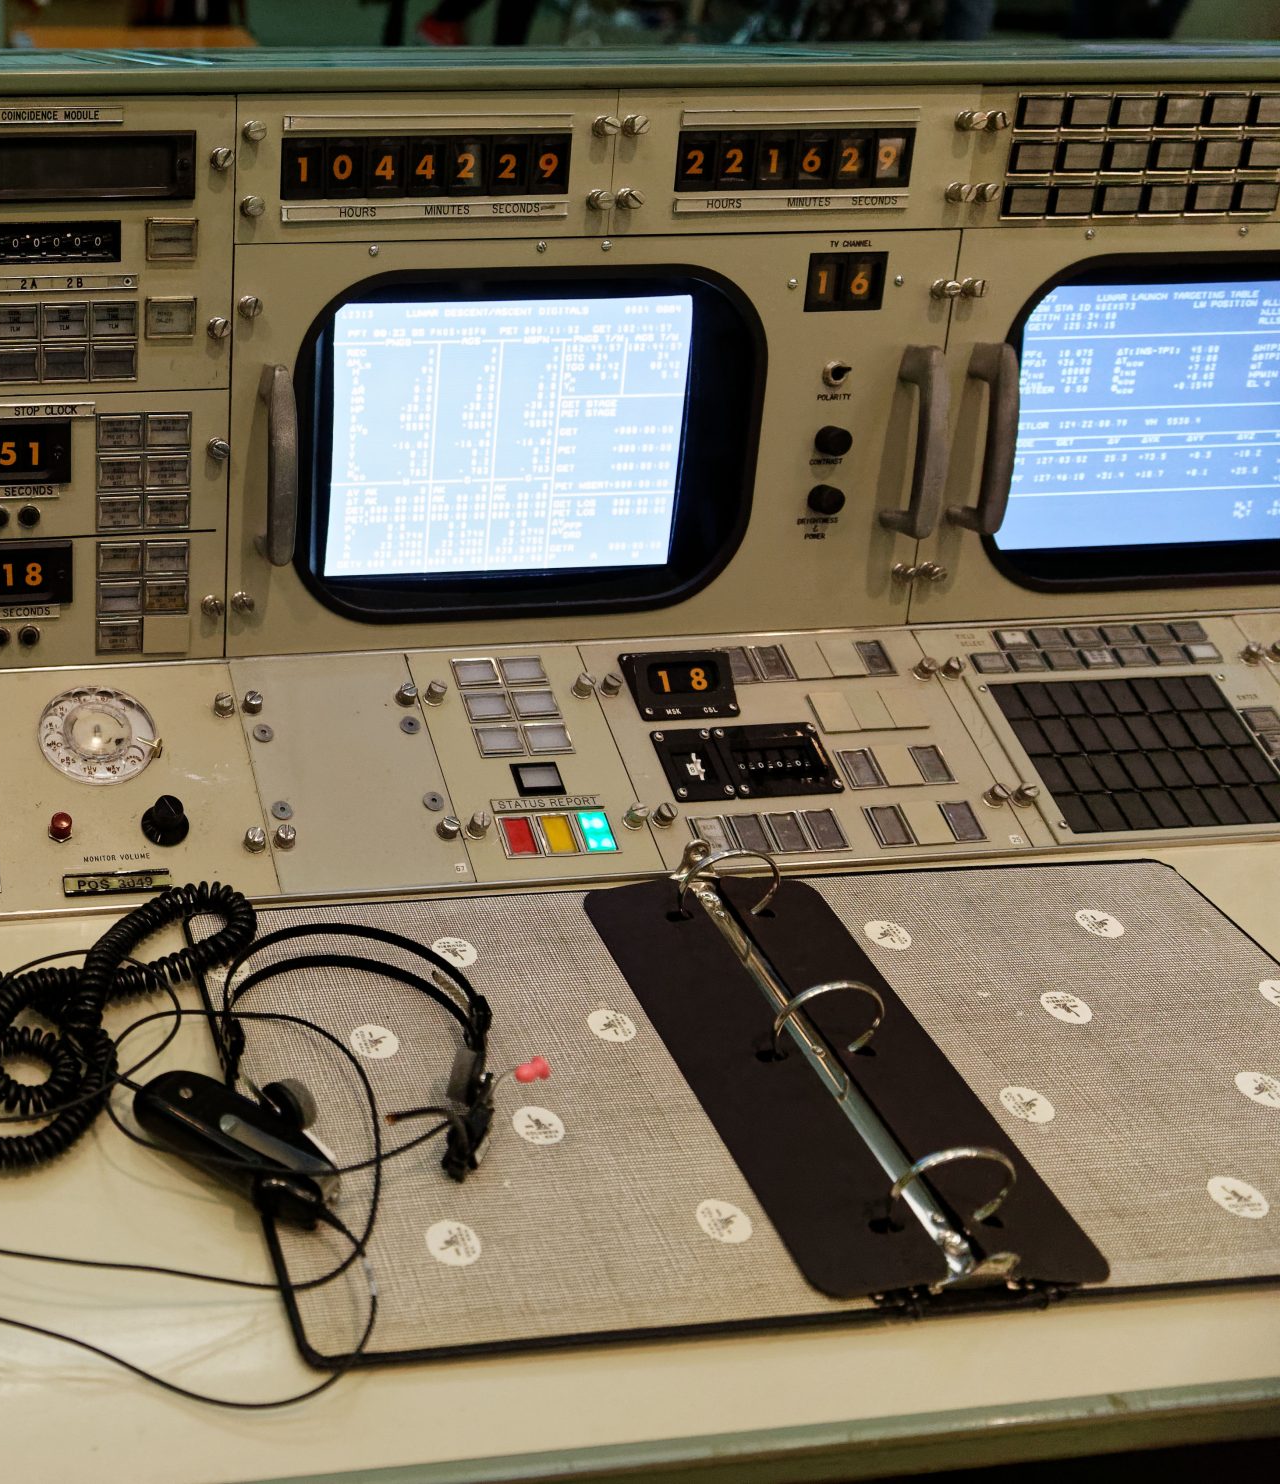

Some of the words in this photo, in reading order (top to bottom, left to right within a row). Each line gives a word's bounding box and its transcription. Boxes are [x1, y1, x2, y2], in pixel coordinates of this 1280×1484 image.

[1, 110, 61, 121] COINCIDENCE
[64, 109, 100, 120] MODULE
[706, 198, 742, 209] HOURS
[787, 196, 831, 208] MINUTES
[851, 195, 898, 206] SECONDS
[339, 206, 376, 217] HOURS
[424, 204, 470, 216] MINUTES
[492, 202, 540, 214] SECONDS
[830, 240, 839, 248] TV
[842, 239, 873, 248] CHANNEL
[1097, 293, 1128, 302] LUNAR
[1131, 292, 1169, 302] LAUNCH
[1173, 290, 1226, 300] TARGETING
[1230, 289, 1260, 299] TABLE
[1209, 299, 1258, 309] POSITION
[406, 308, 439, 318] LUNAR
[539, 305, 589, 316] DIGITALS
[817, 393, 851, 401] POLARITY
[14, 405, 41, 416] STOP
[44, 404, 78, 415] CLOCK
[4, 486, 54, 497] SECONDS
[797, 517, 838, 525] BRIGHTNESS
[2, 606, 51, 618] SECONDS
[665, 708, 682, 716] MSK
[703, 706, 719, 714] CSL
[497, 797, 547, 810] STATUS
[549, 795, 597, 808] REPORT
[83, 853, 117, 863] MONITOR
[120, 852, 151, 862] VOLUME
[77, 877, 111, 890] POS
[118, 876, 154, 889] 3049
